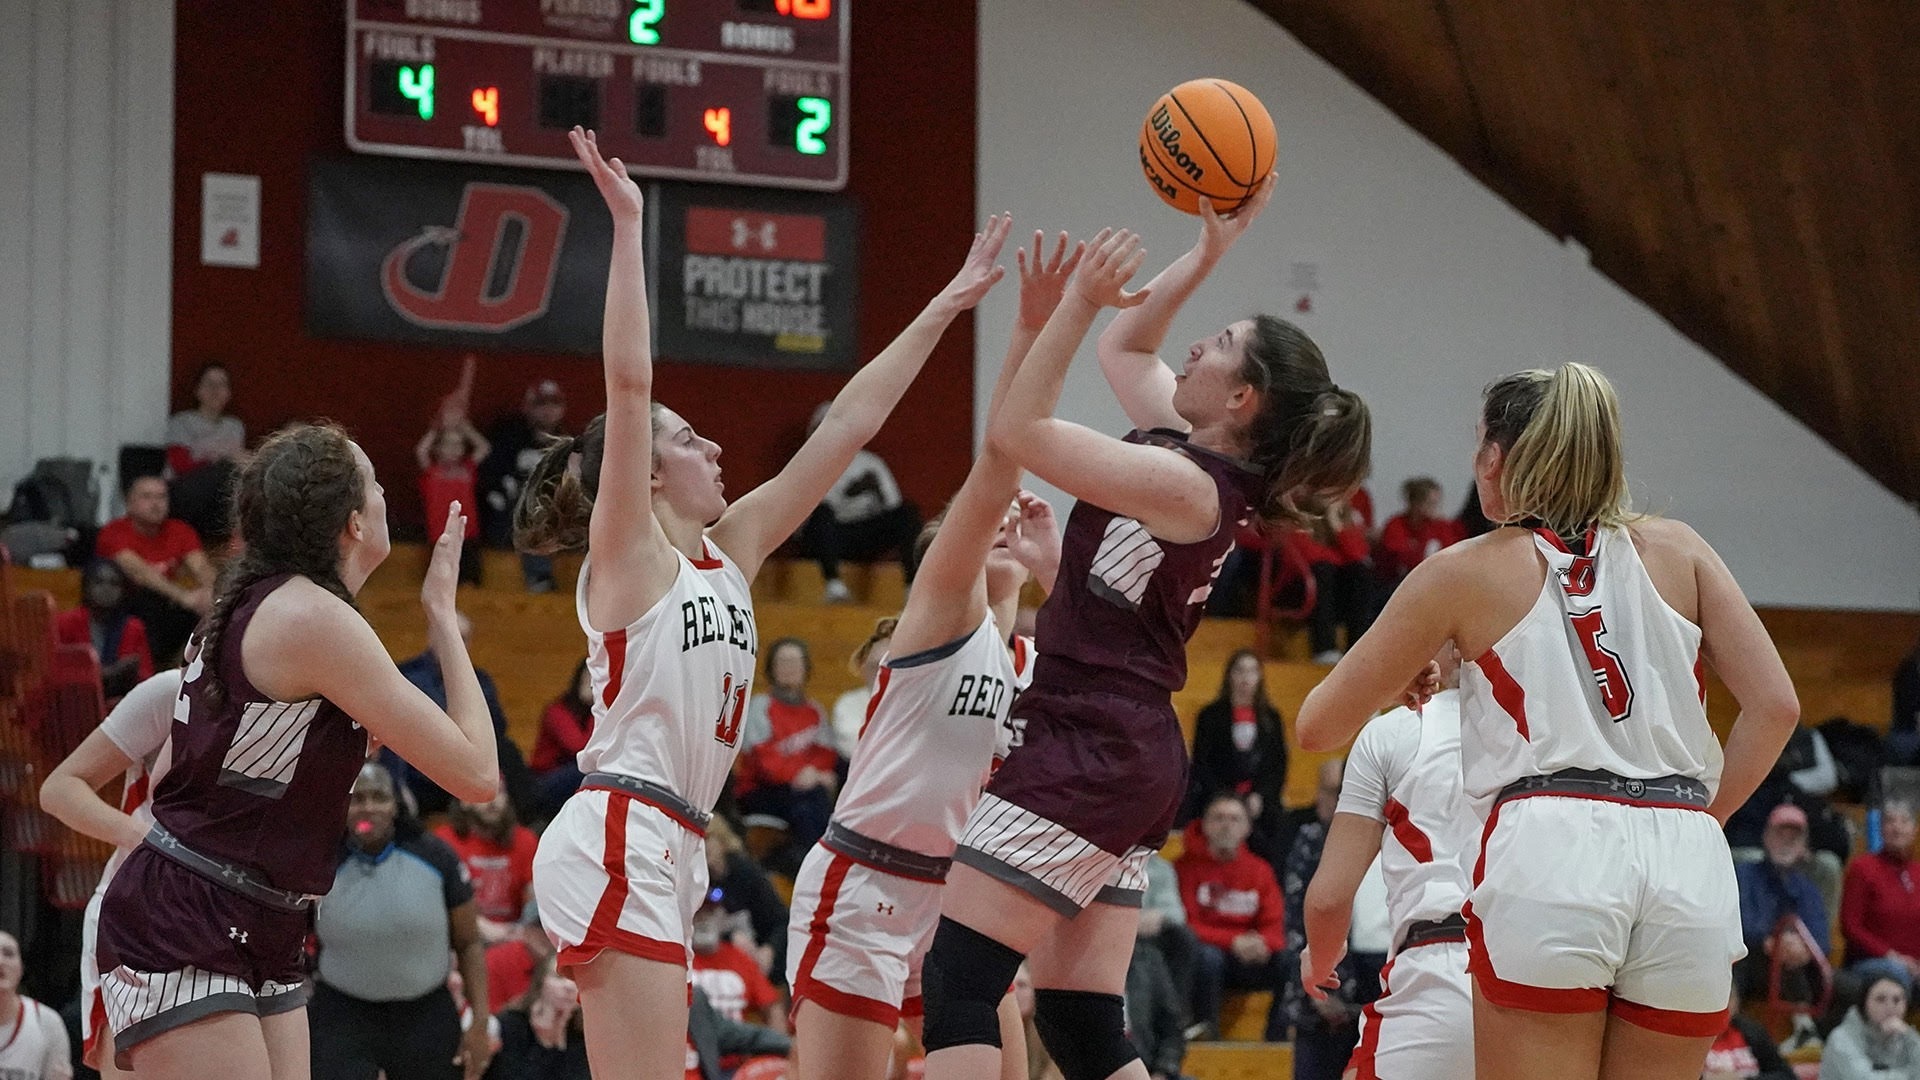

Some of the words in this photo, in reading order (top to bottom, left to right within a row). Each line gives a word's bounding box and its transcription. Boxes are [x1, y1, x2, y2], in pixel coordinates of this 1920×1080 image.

[399, 64, 434, 120] 4
[472, 86, 499, 127] 4
[704, 107, 731, 147] 4
[796, 97, 832, 155] 2
[1151, 103, 1204, 182] Wilson
[684, 253, 831, 304] PROTECT
[685, 296, 739, 333] THIS
[741, 300, 831, 337] HOUSE
[1568, 605, 1635, 723] 5
[714, 671, 749, 748] 11
[948, 674, 1005, 720] RED
